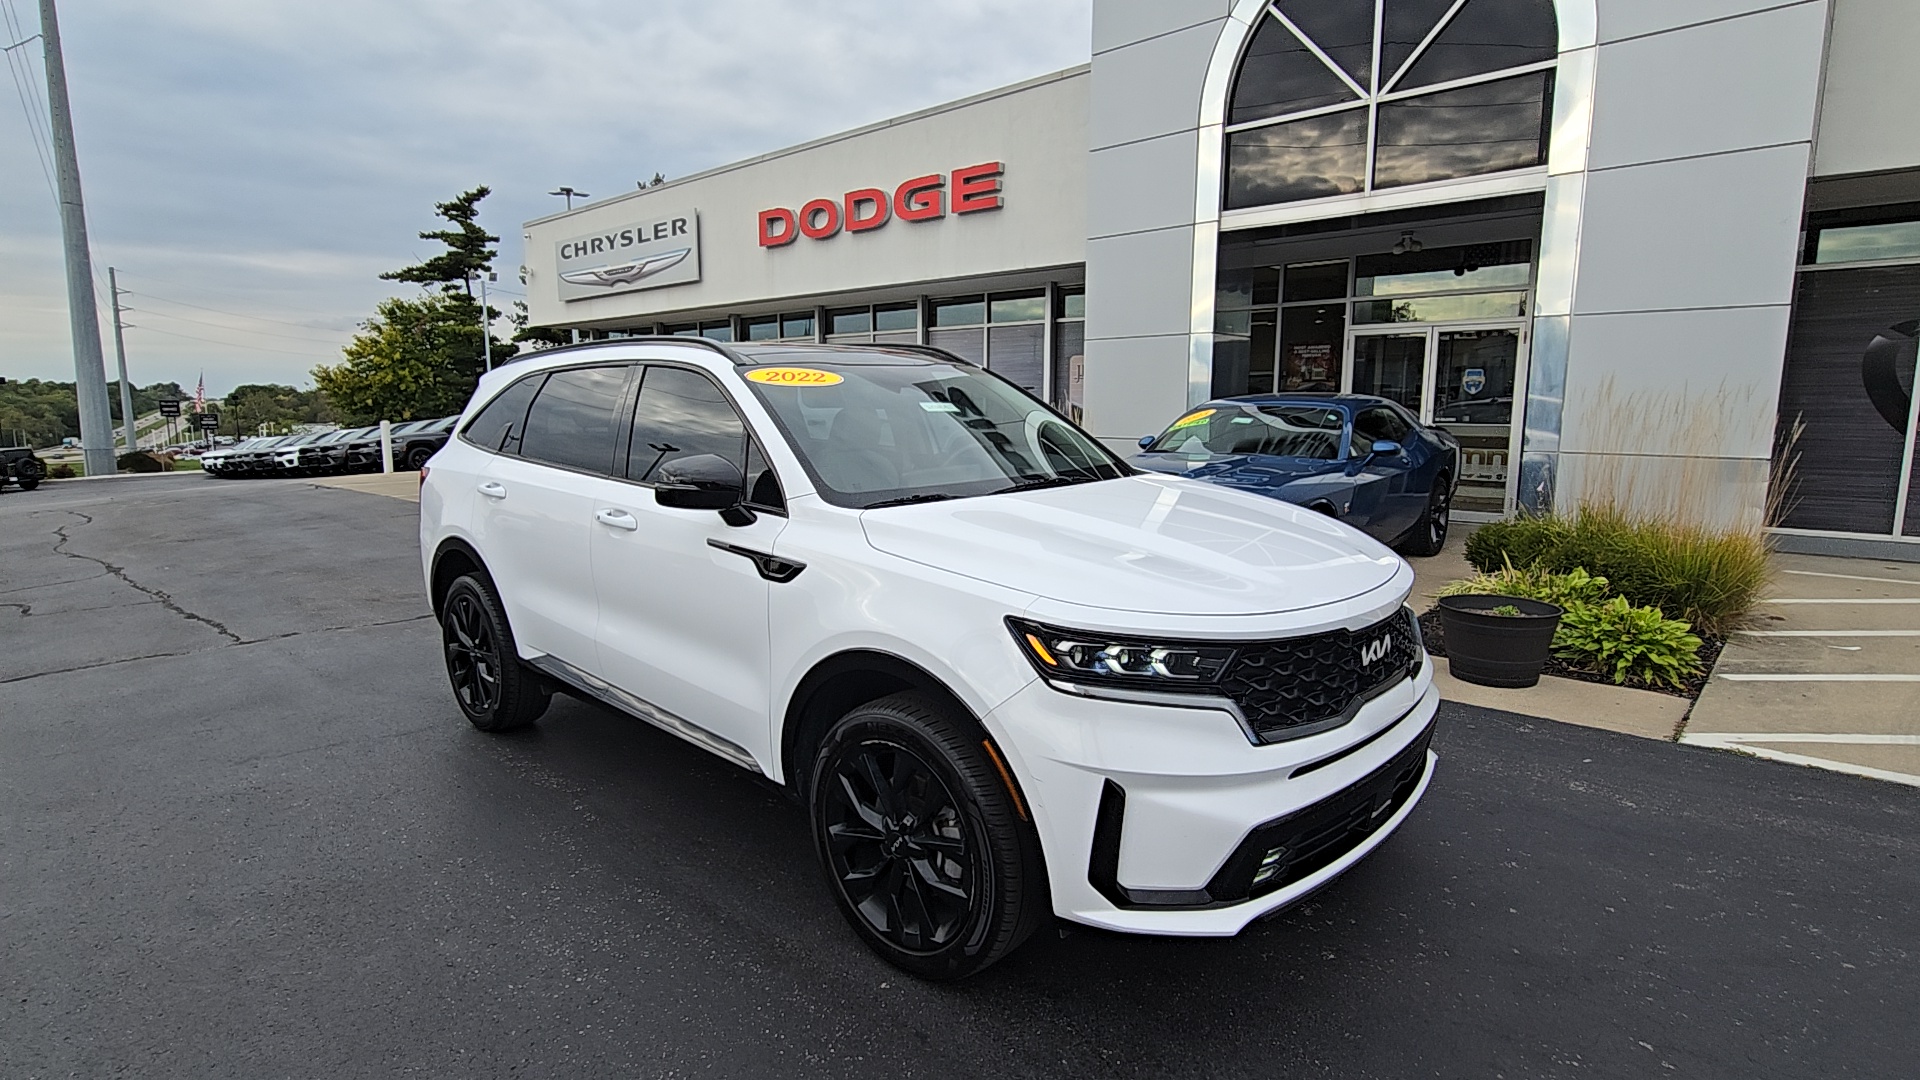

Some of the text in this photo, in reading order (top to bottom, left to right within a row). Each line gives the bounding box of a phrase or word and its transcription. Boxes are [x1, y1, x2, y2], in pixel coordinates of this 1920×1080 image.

[758, 161, 1005, 247] DODGE
[560, 217, 688, 260] CHRYSLER
[765, 371, 826, 382] 2022
